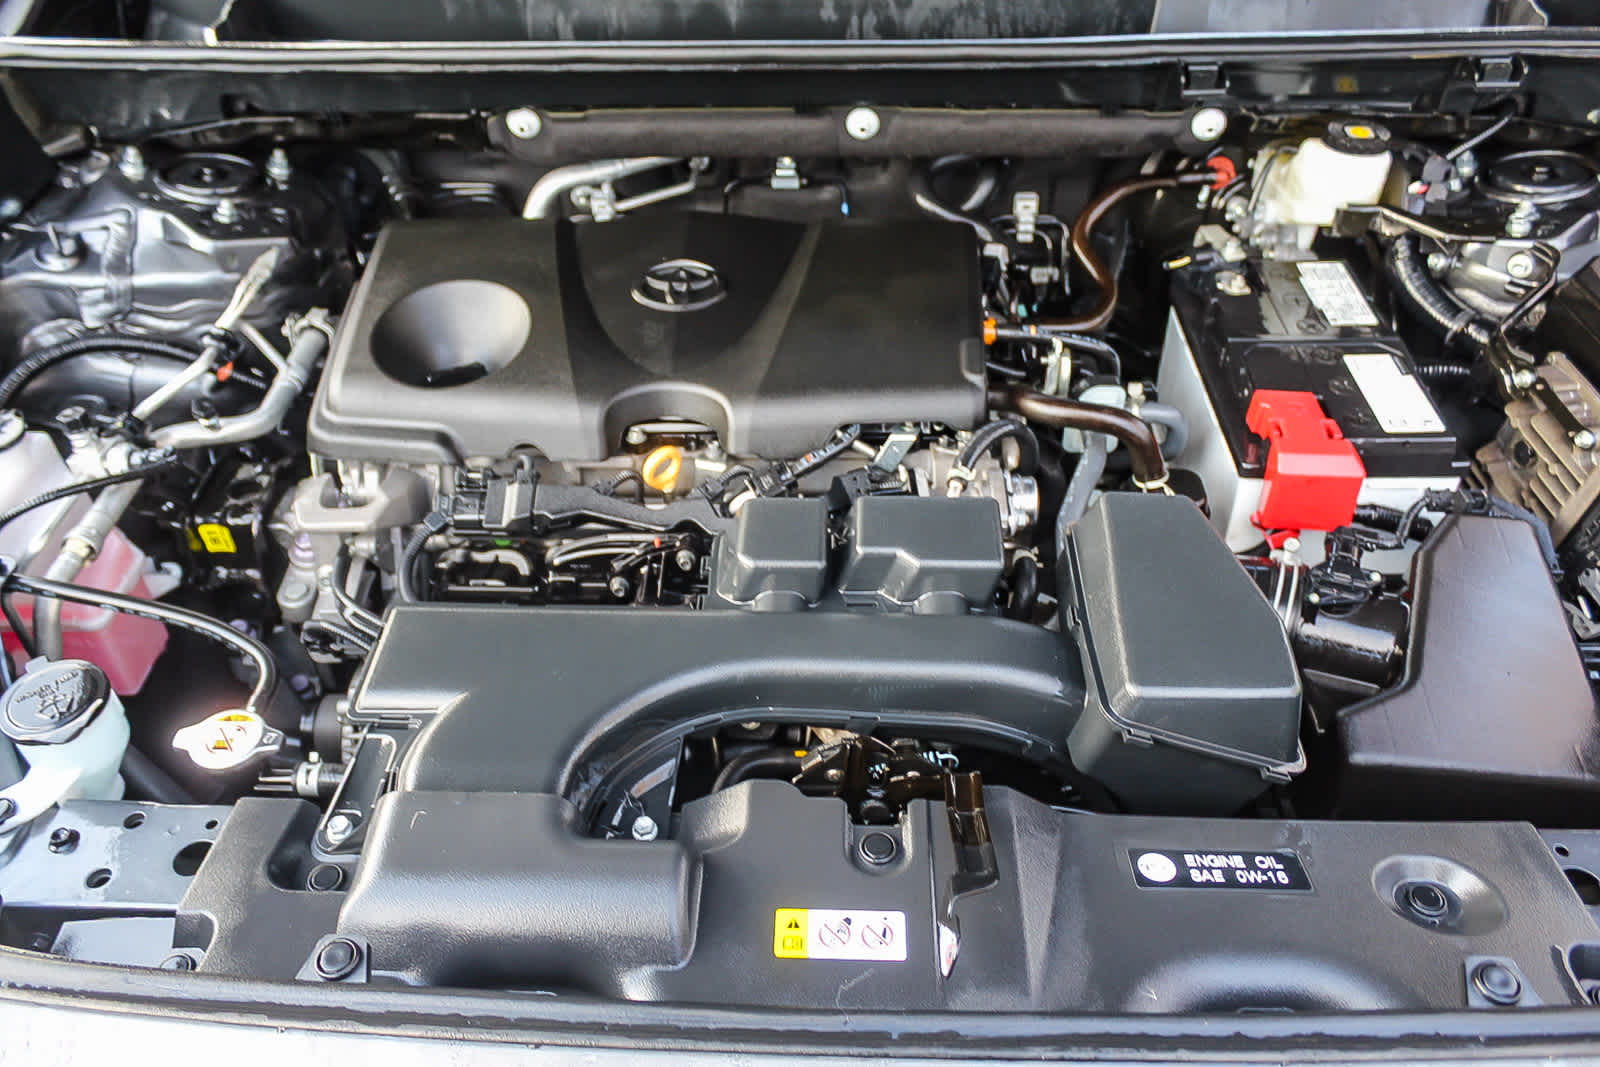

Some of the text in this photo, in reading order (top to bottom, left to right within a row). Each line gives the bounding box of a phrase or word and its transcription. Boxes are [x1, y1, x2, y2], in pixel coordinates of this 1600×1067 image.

[1183, 854, 1246, 868] ENGINE
[1254, 855, 1284, 870] OIL
[1189, 869, 1289, 884] SAE 0W-16
